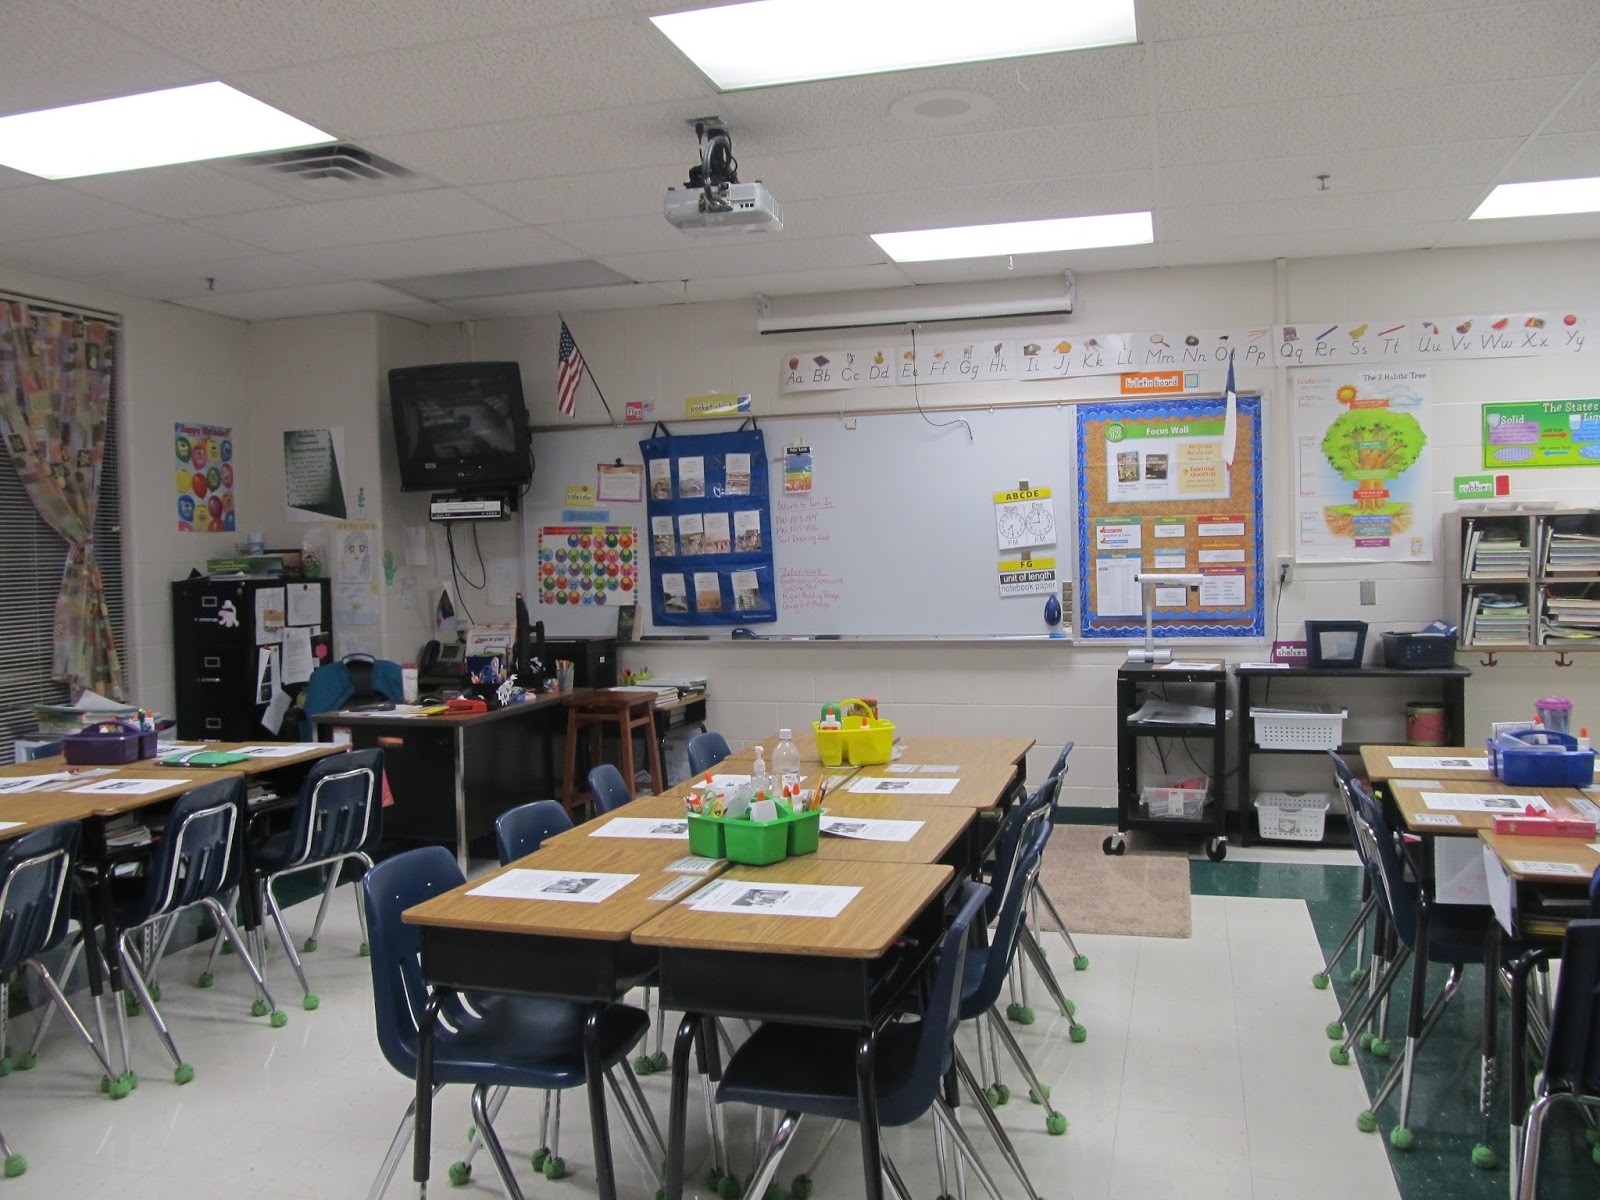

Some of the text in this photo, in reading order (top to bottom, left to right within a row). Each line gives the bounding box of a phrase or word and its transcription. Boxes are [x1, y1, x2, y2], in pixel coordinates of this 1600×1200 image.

[785, 371, 804, 385] Aa
[813, 366, 831, 382] Bb
[841, 367, 860, 381] Cc
[869, 364, 890, 380] Dd
[930, 360, 950, 377] Ff
[959, 361, 979, 380] Gg
[989, 358, 1008, 372] Hh
[1026, 357, 1040, 372] Ii
[1053, 356, 1071, 376] Jj
[1082, 353, 1103, 368] Kk
[1116, 350, 1133, 365] Ll
[1144, 349, 1175, 364] Mm
[1182, 347, 1206, 363] Nn
[1245, 345, 1266, 366] Pp
[1279, 344, 1303, 363] Qq
[1314, 341, 1337, 357] Rr
[1350, 338, 1368, 355] Ss
[1382, 338, 1400, 354] Tt
[1418, 336, 1442, 352] Uu
[1451, 335, 1472, 351] Vv
[1480, 333, 1513, 349] Ww
[1520, 332, 1549, 348] Xx
[1564, 331, 1586, 352] Yy
[1126, 377, 1178, 388] bulletin board
[628, 406, 641, 416] flag
[690, 403, 713, 414] pocket
[1542, 401, 1599, 413] The States
[1500, 414, 1525, 425] Solid
[1109, 429, 1121, 439] 12
[1146, 425, 1189, 435] Focus Wall
[1460, 482, 1492, 492] cubbies
[1003, 571, 1052, 582] unit of length
[1001, 582, 1056, 593] notebook paper
[1277, 647, 1306, 656] shelves
